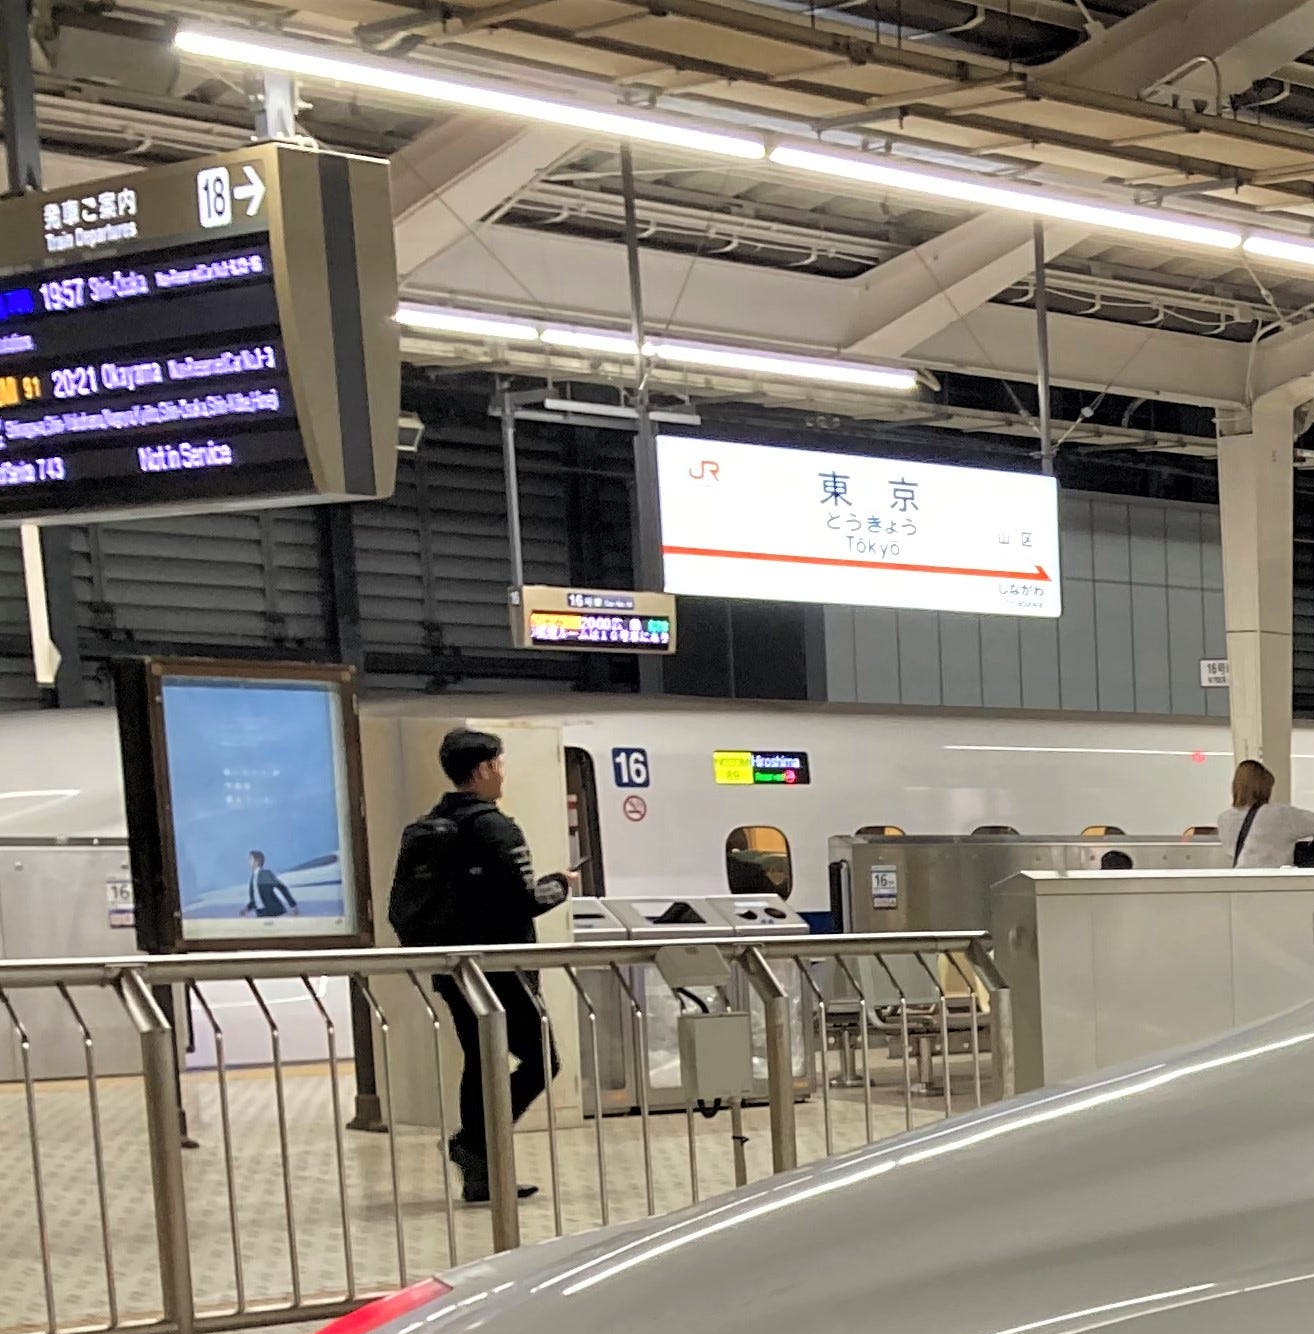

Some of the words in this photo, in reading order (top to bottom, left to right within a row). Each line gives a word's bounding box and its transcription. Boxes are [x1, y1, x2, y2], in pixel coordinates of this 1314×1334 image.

[203, 177, 225, 219] 18
[179, 440, 233, 468] Service
[689, 460, 720, 481] JR
[818, 471, 920, 512] 東京
[827, 512, 917, 536] とうきょう
[999, 583, 1045, 598] しながわ
[615, 752, 647, 784] 16
[752, 755, 800, 768] Hiroshima
[874, 873, 888, 887] 16
[111, 883, 130, 901] 16
